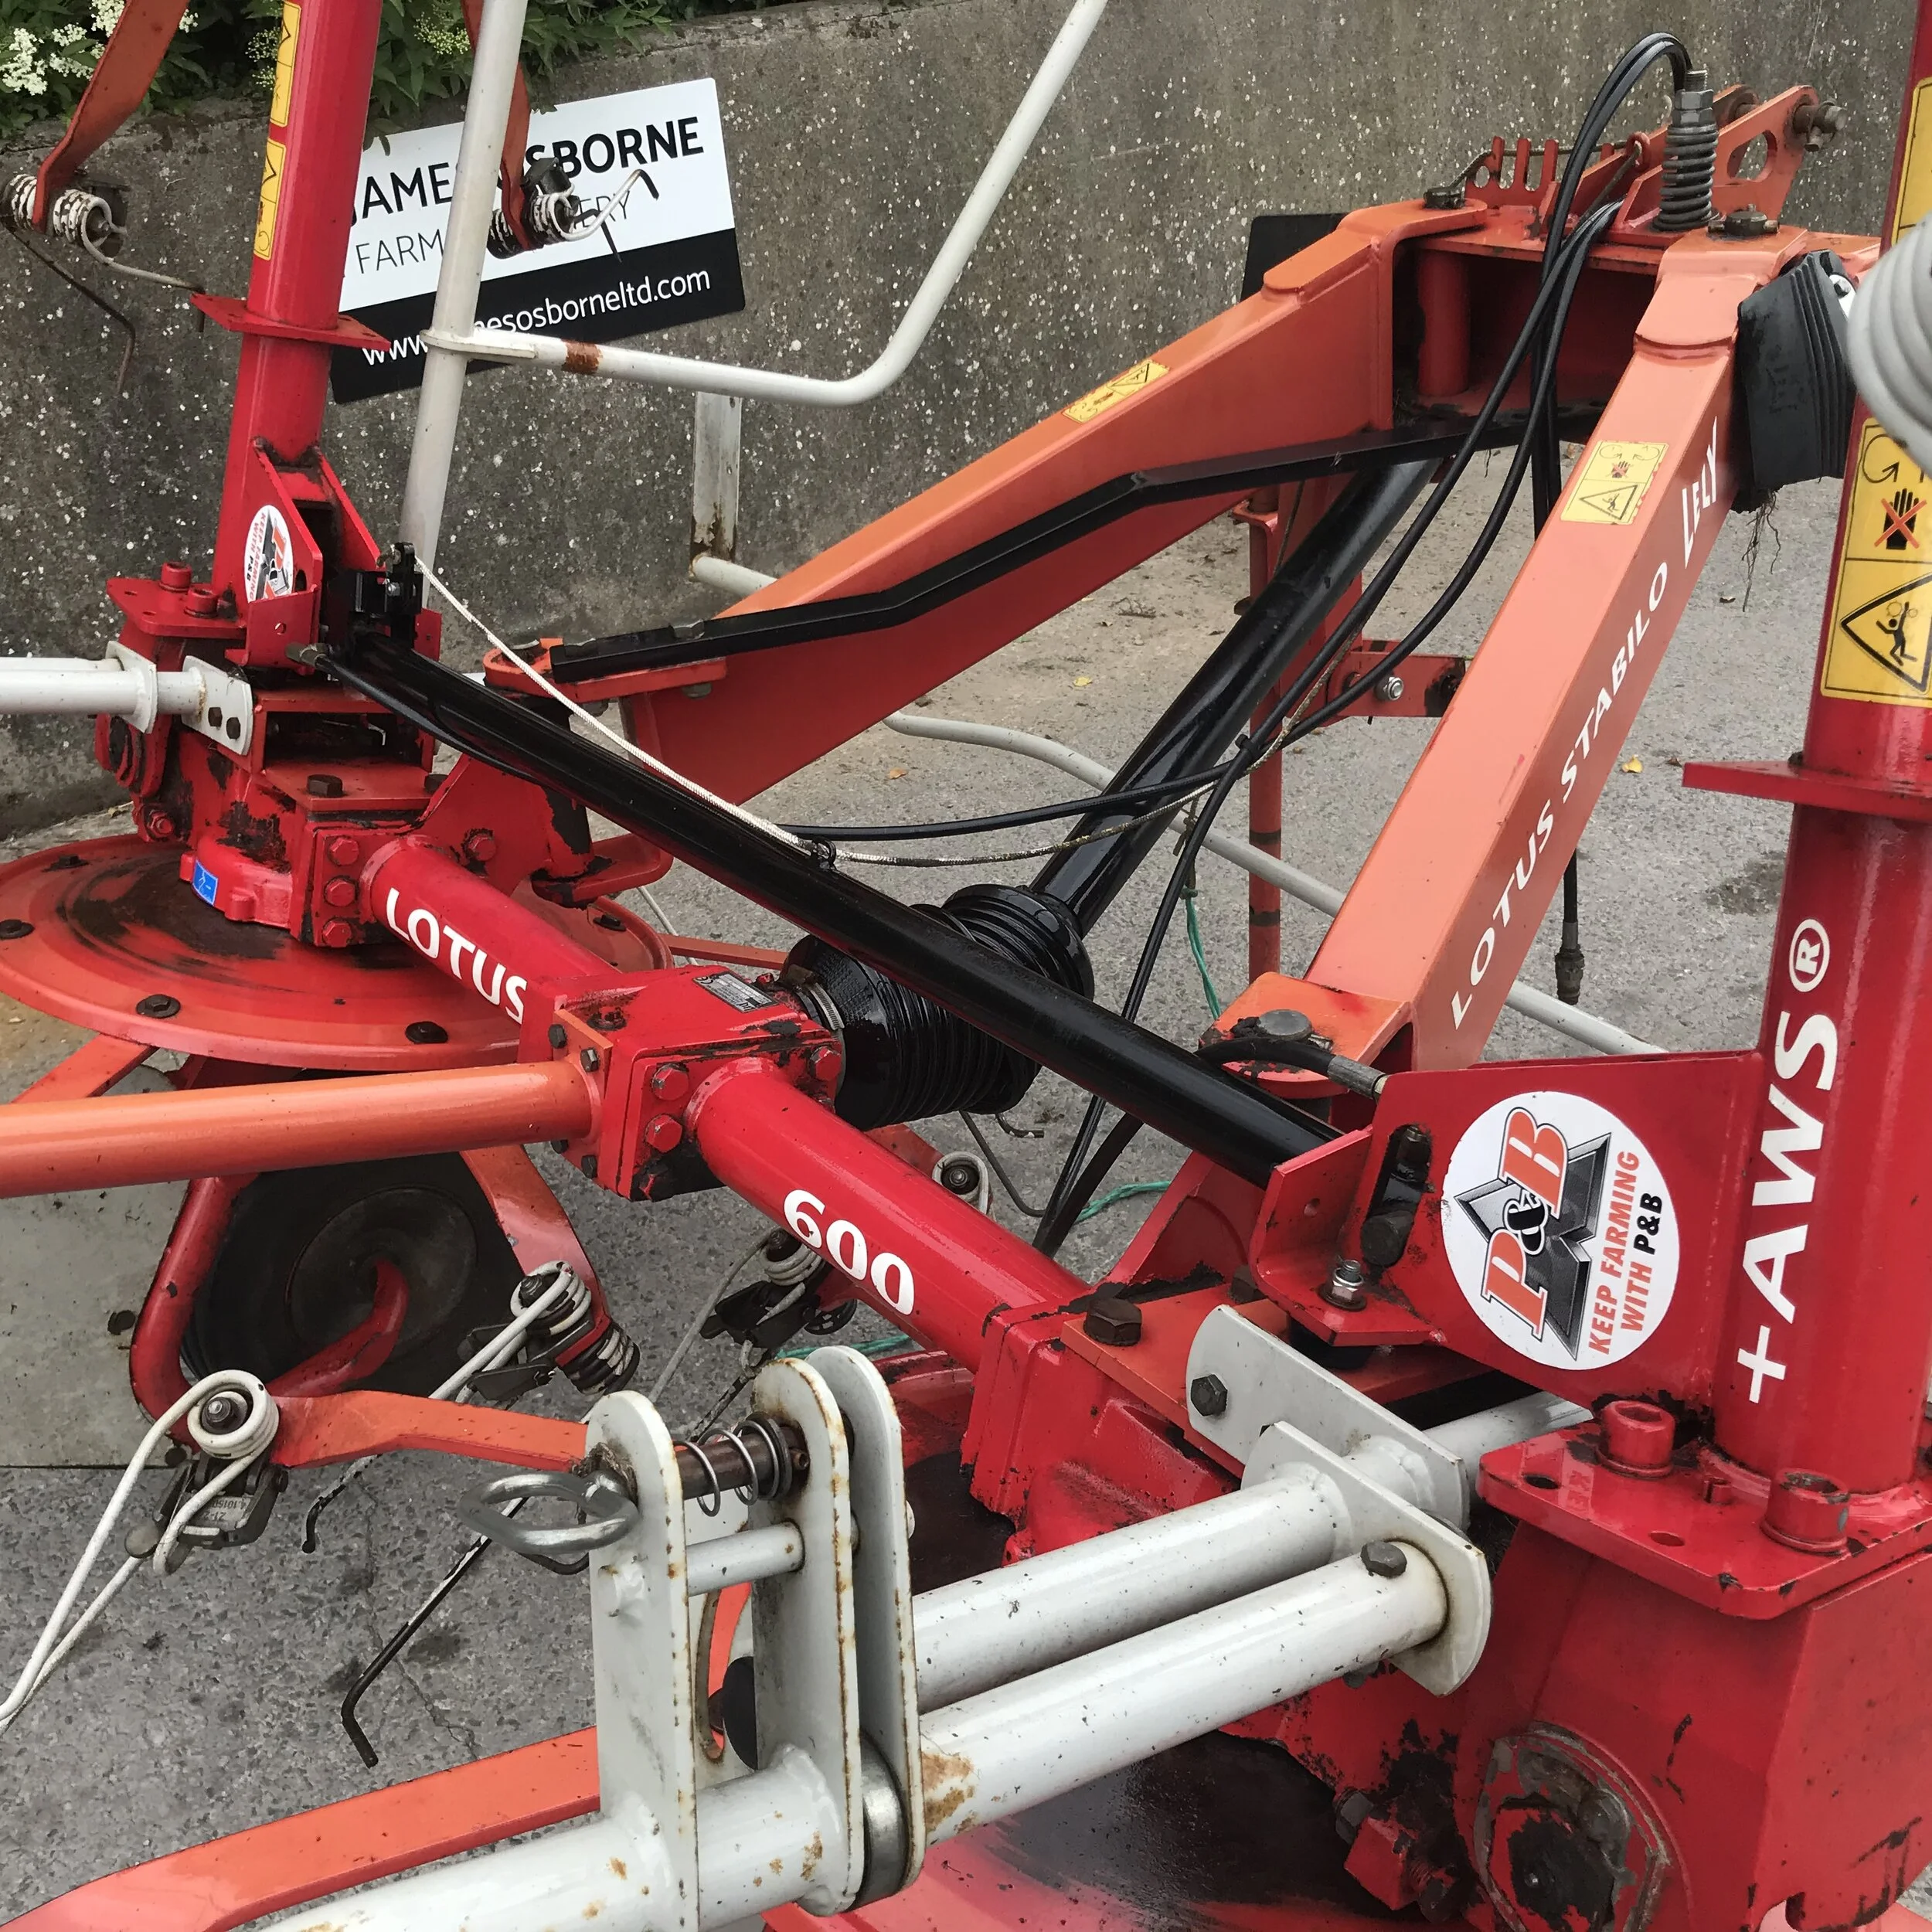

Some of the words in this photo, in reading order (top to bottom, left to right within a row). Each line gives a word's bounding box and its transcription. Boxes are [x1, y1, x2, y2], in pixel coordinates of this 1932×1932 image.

[351, 162, 453, 228] AME
[497, 116, 704, 190] SBORNE
[1682, 415, 1717, 570] LELY
[1451, 801, 1555, 1031] LOTUS
[1561, 559, 1668, 804] STABILO
[386, 888, 528, 1026] LOTUS
[783, 1189, 916, 1315] 600
[1480, 1107, 1570, 1342] P&B
[1600, 1151, 1639, 1279] FARMING
[1634, 1192, 1662, 1255] P&B
[1588, 1286, 1618, 1355] KEEP
[1621, 1265, 1653, 1332] WITH
